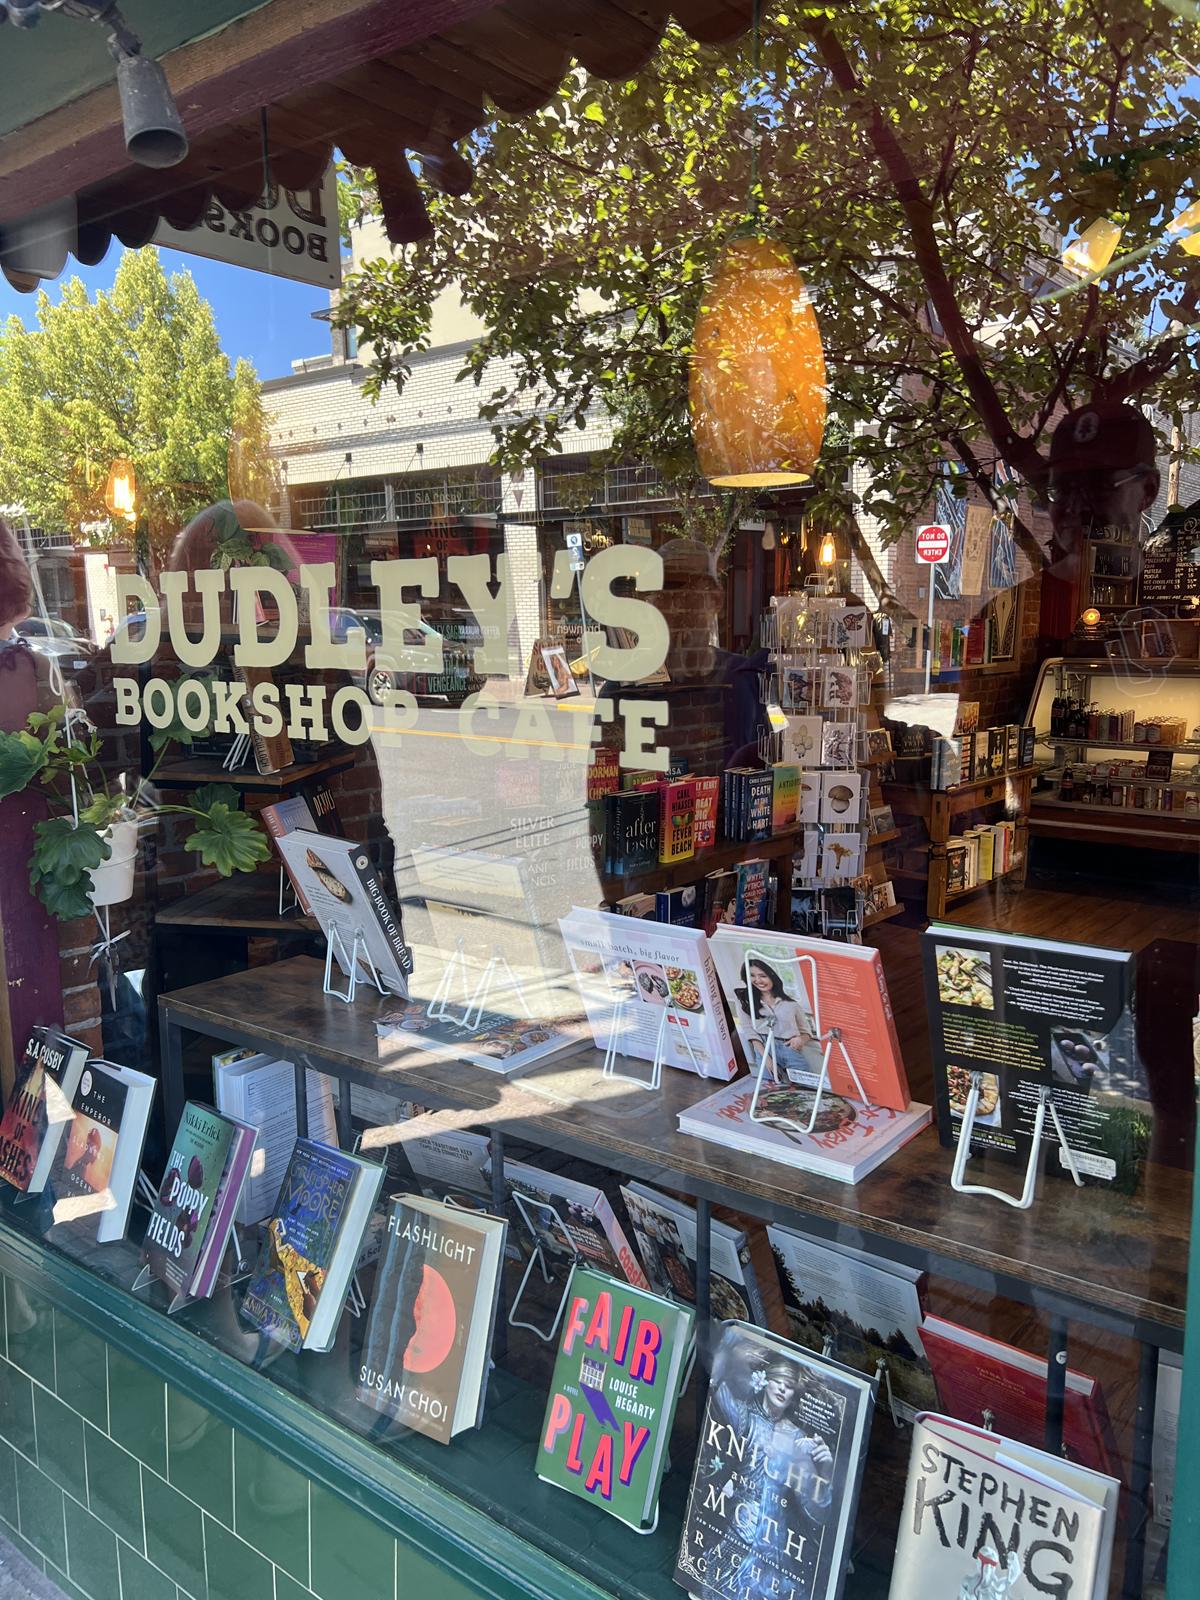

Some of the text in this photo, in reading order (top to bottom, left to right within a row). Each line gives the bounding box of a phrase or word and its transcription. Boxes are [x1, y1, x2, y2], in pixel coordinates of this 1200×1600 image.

[111, 545, 670, 681] DUDLEY'S
[428, 676, 467, 693] VENGEANCE
[114, 678, 671, 772] BOOKSHOP CAFE
[677, 789, 690, 800] CARL
[751, 785, 771, 796] DEATH
[672, 799, 693, 812] HIAASEN
[750, 806, 770, 818] WHITE
[510, 816, 554, 831] SILVER
[625, 817, 657, 838] after
[673, 827, 692, 841] FEVER
[752, 818, 769, 830] HART
[516, 833, 550, 848] ELITE
[626, 835, 657, 855] taste
[672, 840, 692, 856] BEACH
[366, 878, 412, 970] BIG BOOK OF BREAD
[639, 947, 652, 959] big
[654, 951, 680, 962] flavor
[704, 957, 719, 1001] baking
[718, 1016, 727, 1041] two
[25, 1038, 65, 1072] S.A. COSBY
[94, 1091, 106, 1104] THE
[81, 1103, 112, 1125] EMPEROR
[170, 1151, 187, 1173] THE
[70, 1173, 92, 1193] OCEAN
[169, 1176, 210, 1222] POPPY
[286, 1177, 340, 1224] MOORE
[147, 1211, 186, 1258] FIELDS
[388, 1214, 476, 1265] FLASHLIGHT
[562, 1290, 662, 1385] FAIR
[360, 1365, 405, 1401] SUSAN
[408, 1389, 449, 1423] CHOI
[609, 1376, 639, 1399] LOUISE
[615, 1395, 656, 1421] HEGARTY
[543, 1392, 651, 1502] PLAY
[706, 1417, 830, 1503] KNIGHT
[921, 1443, 1080, 1542] STEPHEN
[703, 1484, 807, 1563] MOTH
[913, 1476, 1075, 1600] KING
[696, 1516, 806, 1585] NEW YORK TIMES BESTSELLING AUTHOR
